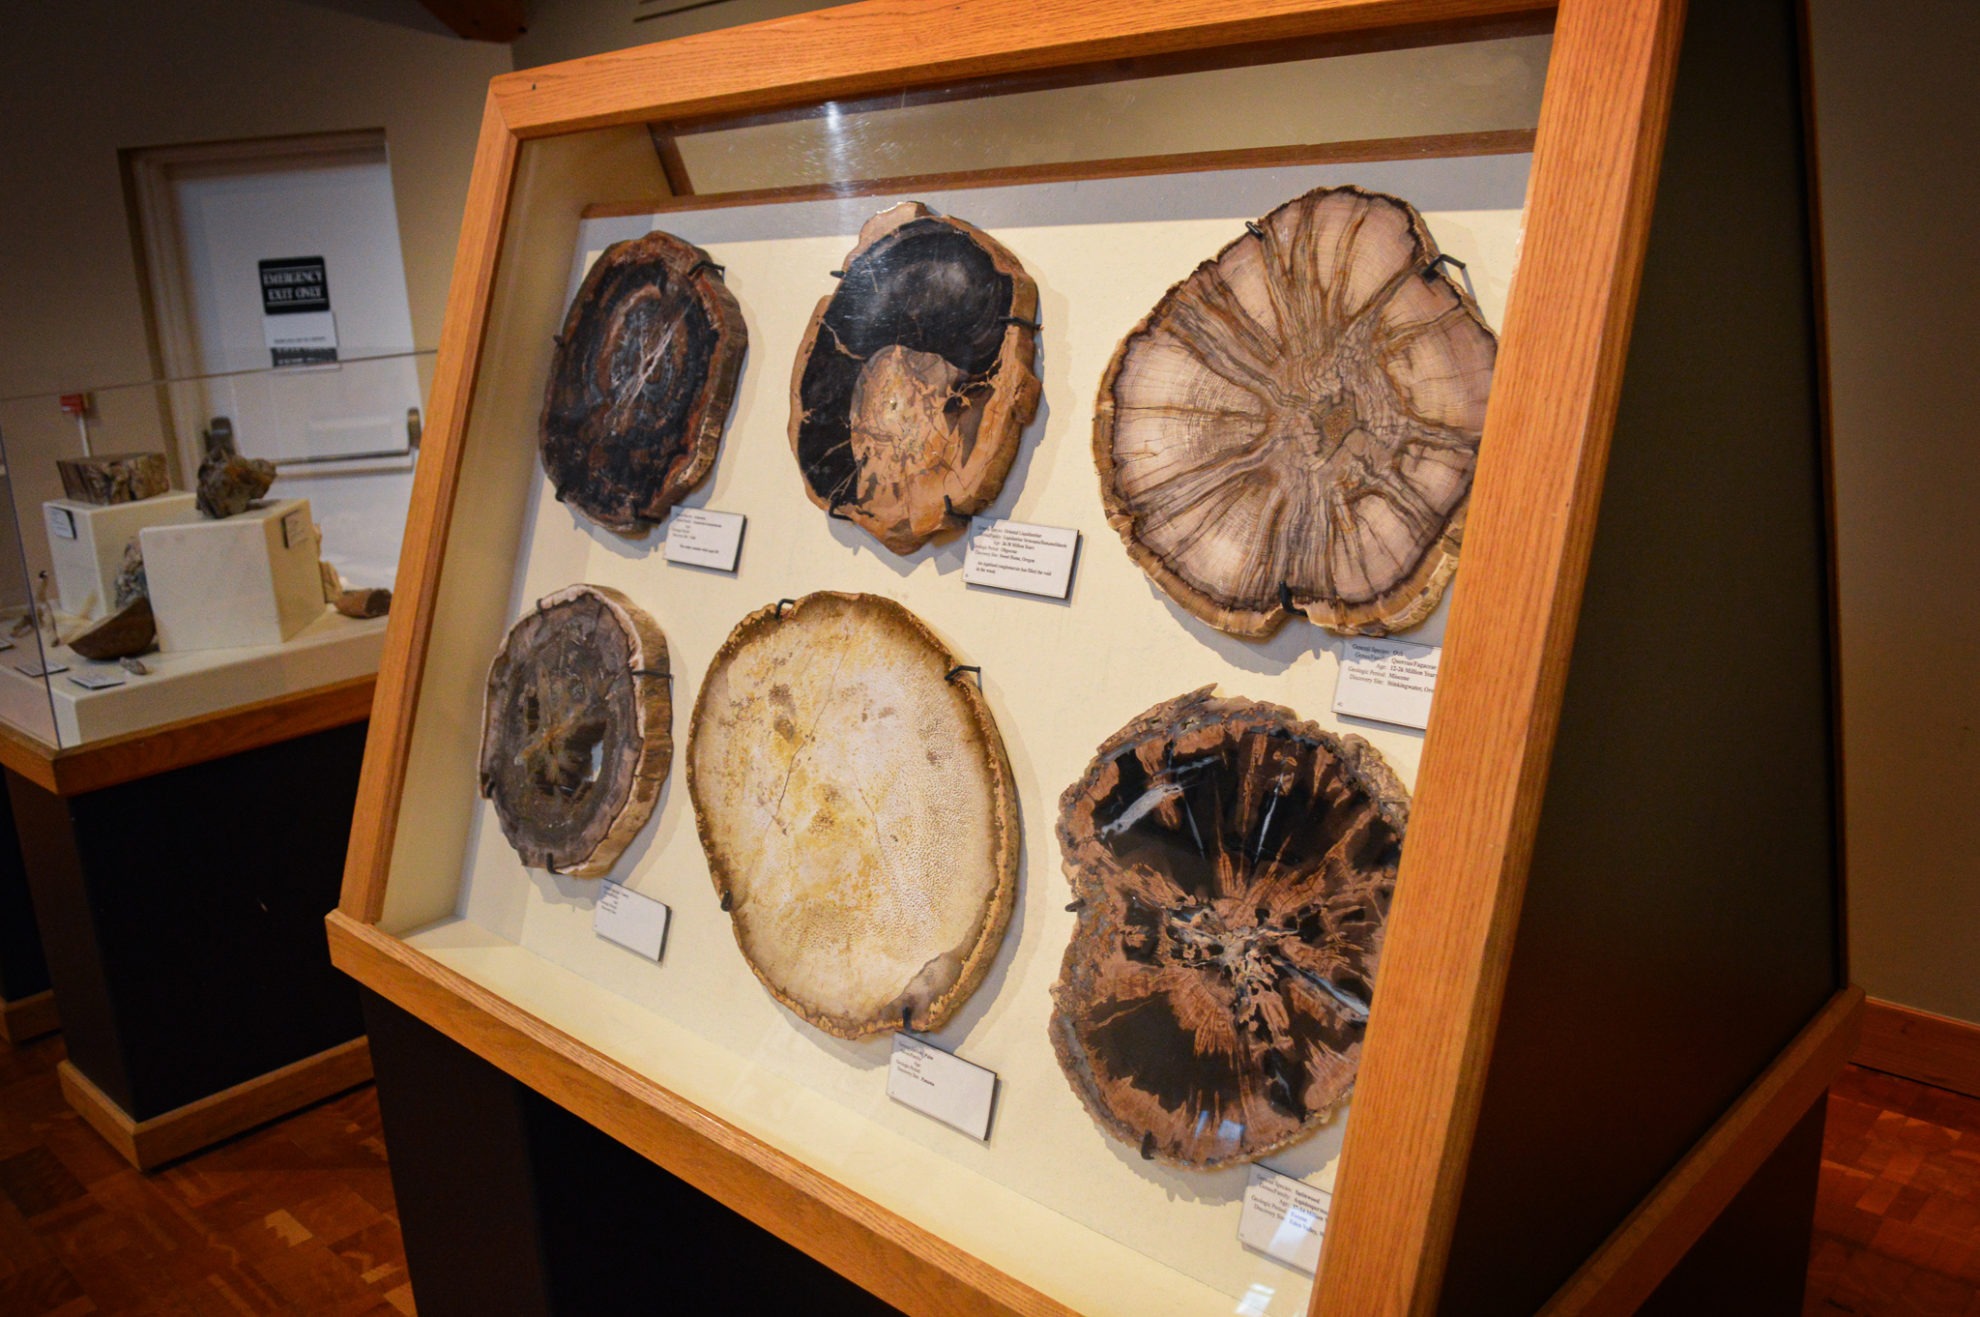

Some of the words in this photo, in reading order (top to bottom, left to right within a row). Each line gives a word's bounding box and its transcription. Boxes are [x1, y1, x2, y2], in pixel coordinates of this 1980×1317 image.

[263, 270, 323, 286] EMERGENCY
[268, 287, 293, 301] EXIT
[295, 285, 322, 299] ONLY
